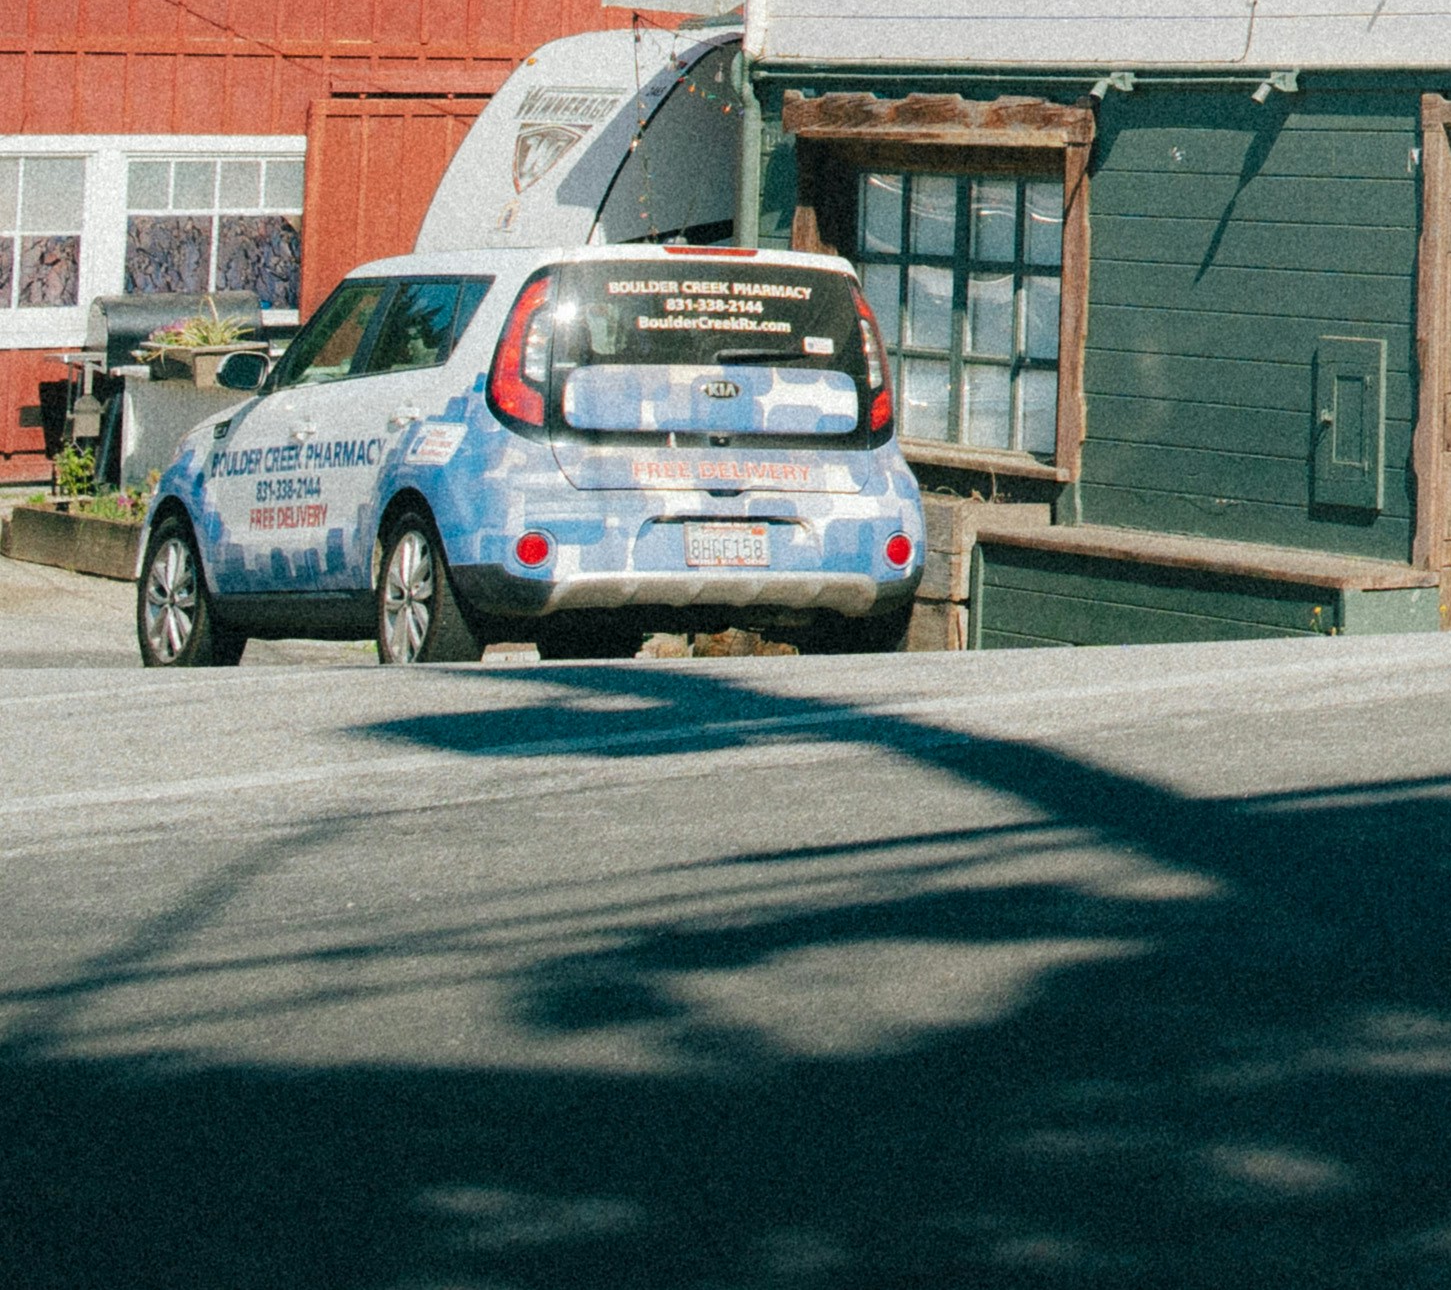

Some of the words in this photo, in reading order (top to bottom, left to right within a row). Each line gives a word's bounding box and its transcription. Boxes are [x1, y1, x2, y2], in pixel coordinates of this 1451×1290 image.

[608, 281, 679, 295] BOULDER
[681, 281, 729, 295] CREEK
[732, 282, 812, 300] PHARMACY
[665, 298, 764, 313] 831-338-2144
[638, 315, 792, 333] BoulderCreekRx.com
[707, 383, 738, 397] KIA
[212, 449, 262, 478] BOULDER
[265, 444, 301, 473] CREEK
[305, 438, 388, 468] PHARMACY
[632, 461, 692, 479] FREE
[700, 462, 811, 481] DELIVERY
[256, 477, 321, 502] 831-338-2144
[250, 506, 275, 531] FREE
[277, 504, 328, 529] DELIVERY
